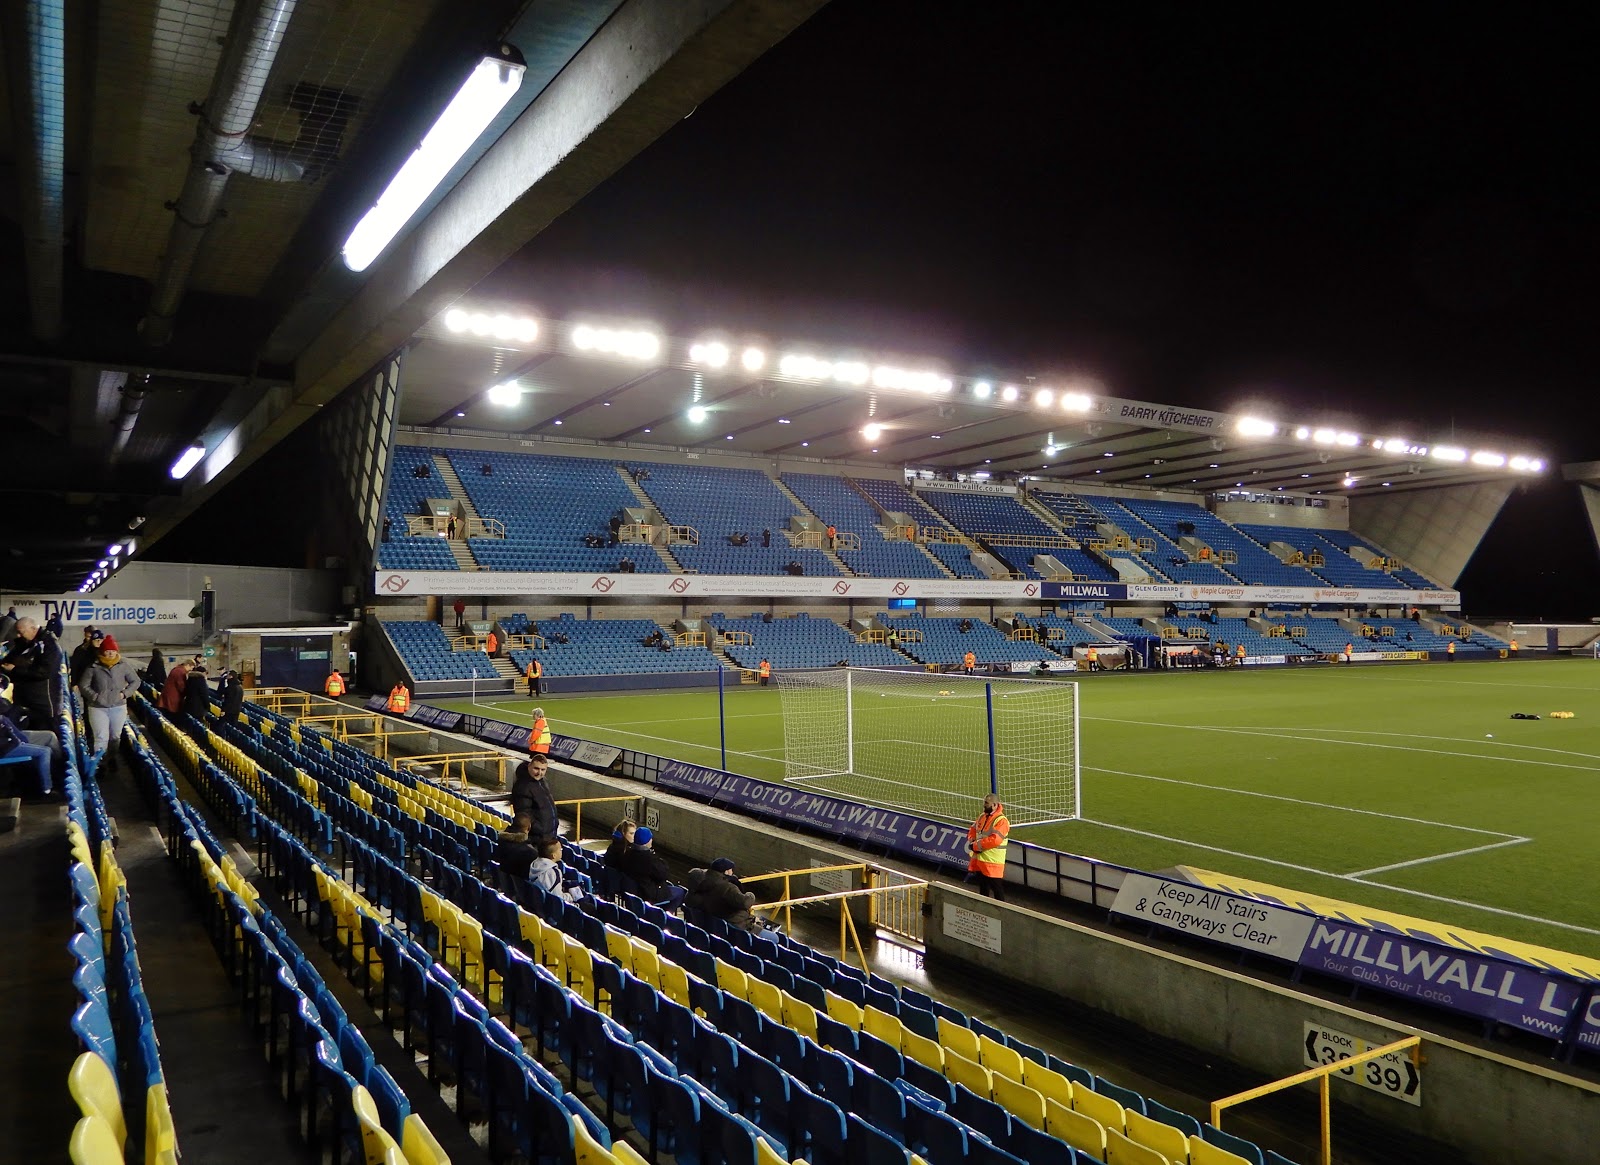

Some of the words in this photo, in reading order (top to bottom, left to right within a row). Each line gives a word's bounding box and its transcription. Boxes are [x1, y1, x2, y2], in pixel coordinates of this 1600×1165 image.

[1121, 405, 1157, 420] BARRY
[1158, 411, 1213, 428] KITCHENER
[1060, 585, 1109, 596] MILLWALL
[1200, 587, 1217, 595] Maple
[1218, 587, 1244, 596] Carpentry
[1322, 589, 1335, 597] Maple
[1337, 590, 1359, 598] Carpentry
[556, 738, 579, 752] LOTTO
[674, 765, 738, 792] MILLWALL
[741, 781, 792, 806] LOTTO
[648, 815, 655, 828] 38
[807, 797, 899, 833] MILLWALL
[1157, 882, 1195, 908] Keep
[1197, 893, 1221, 911] All
[1226, 899, 1268, 922] Stairs
[1135, 898, 1147, 912] &
[1152, 901, 1227, 936] Gangways
[1233, 922, 1277, 946] Clear
[1310, 924, 1524, 1004] MILLWALL
[1323, 956, 1348, 975] Your
[1352, 965, 1381, 984] Club.
[1385, 974, 1413, 992] Your
[1416, 984, 1454, 1005] Lotto.
[1322, 1031, 1352, 1048] BLOCK
[1366, 1061, 1401, 1092] 39
